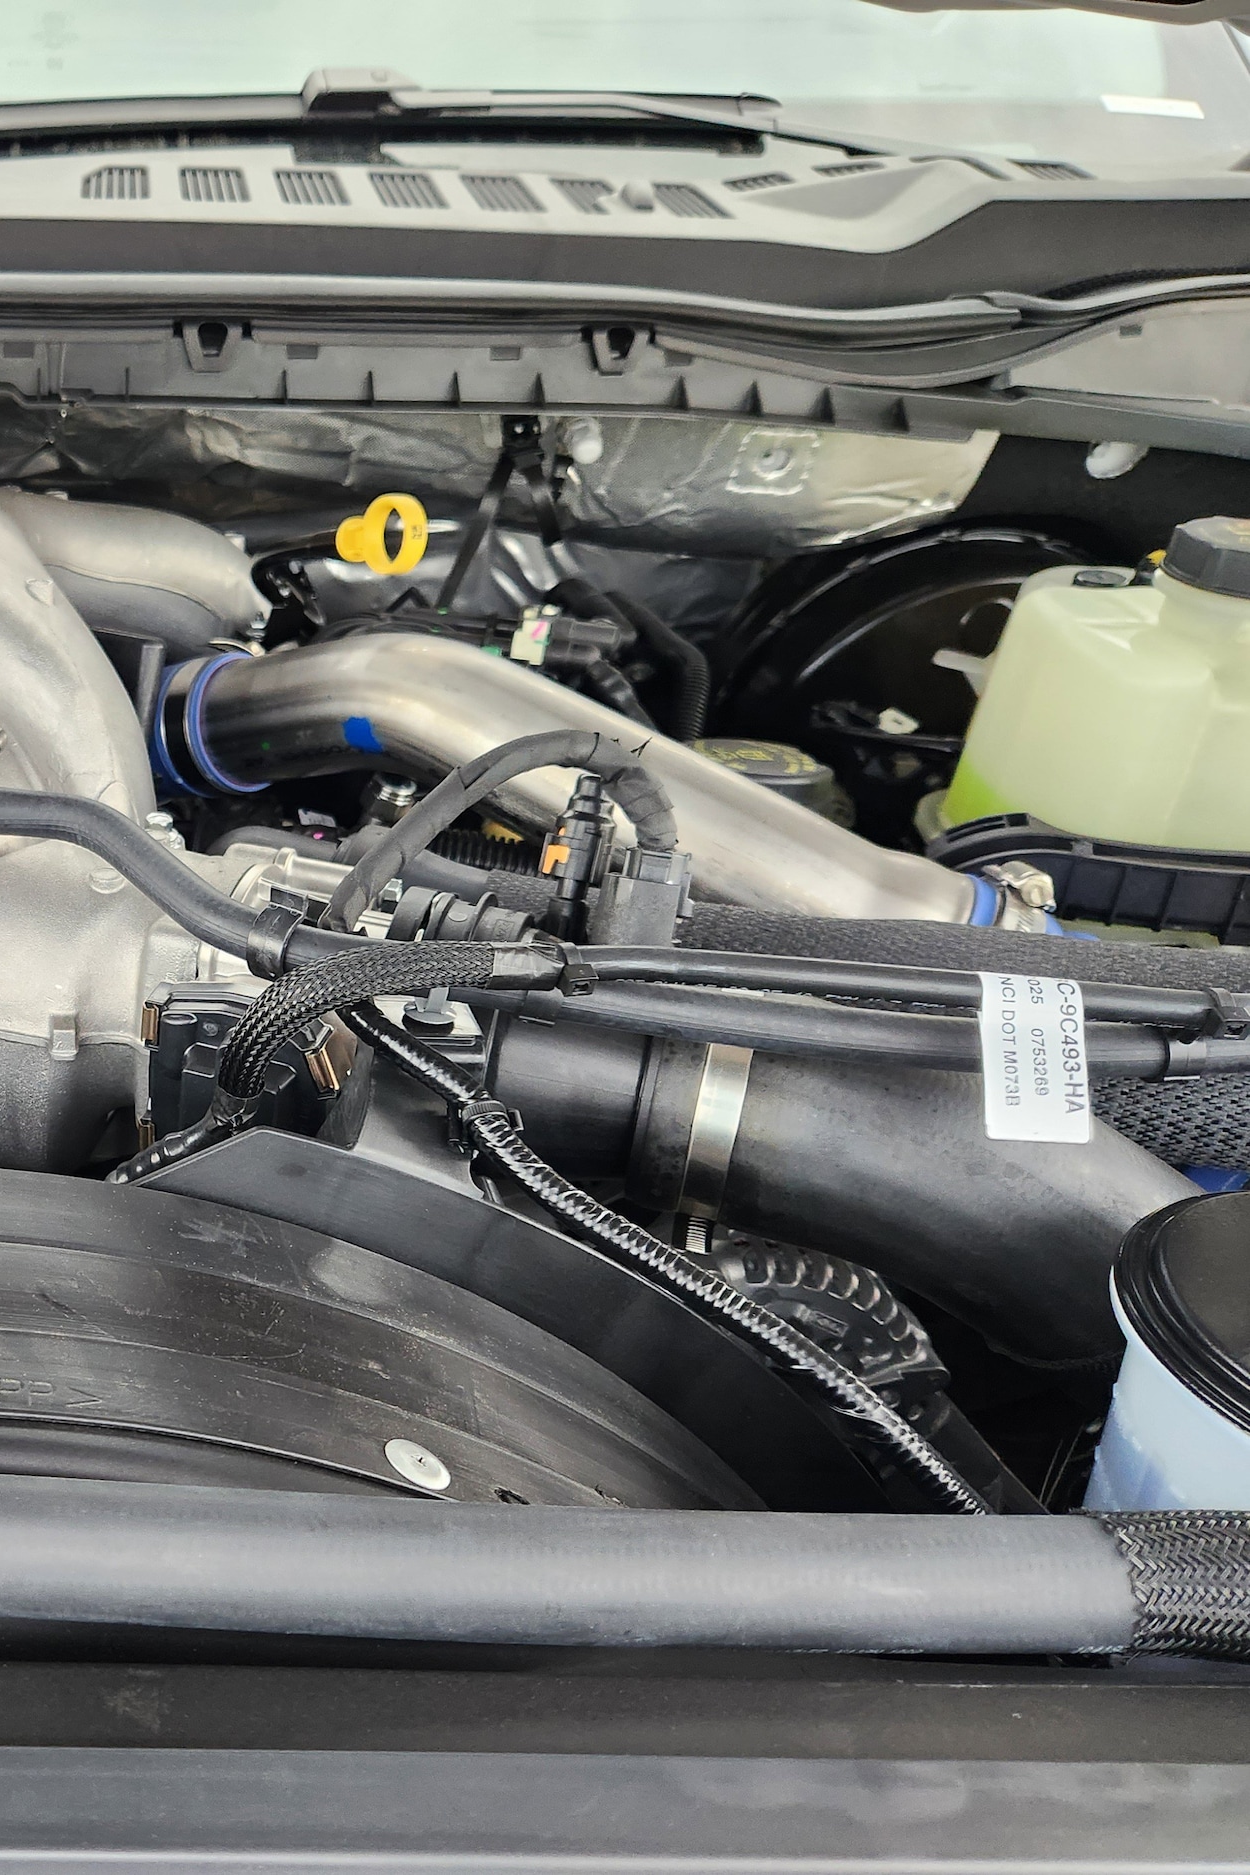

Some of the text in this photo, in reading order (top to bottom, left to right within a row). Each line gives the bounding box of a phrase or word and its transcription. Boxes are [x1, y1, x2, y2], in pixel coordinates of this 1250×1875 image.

[1001, 1010, 1017, 1045] DOT
[1027, 977, 1049, 1096] 025 0753269
[1055, 979, 1085, 1114] C-9C493-HA
